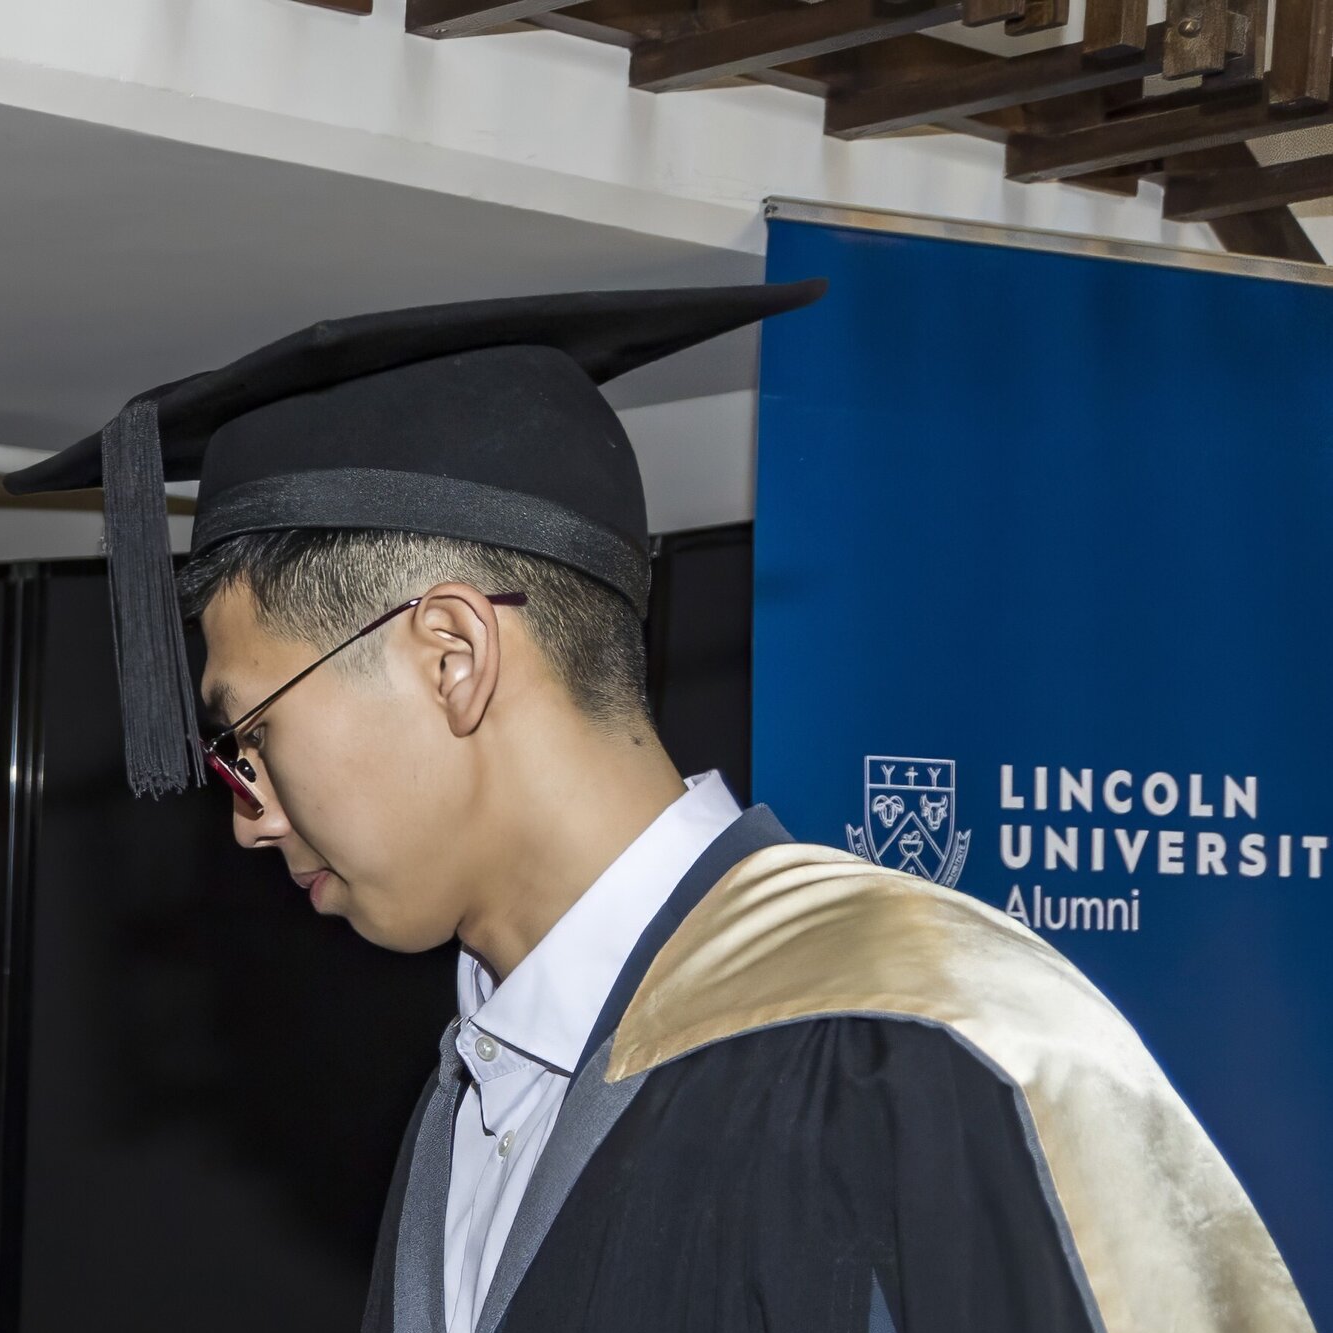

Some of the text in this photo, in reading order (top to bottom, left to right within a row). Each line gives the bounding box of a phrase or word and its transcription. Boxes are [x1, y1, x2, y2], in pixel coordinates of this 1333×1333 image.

[1000, 764, 1257, 819] LINCOLN
[999, 824, 1329, 878] UNIVERSIT
[1005, 884, 1140, 931] Alumni
